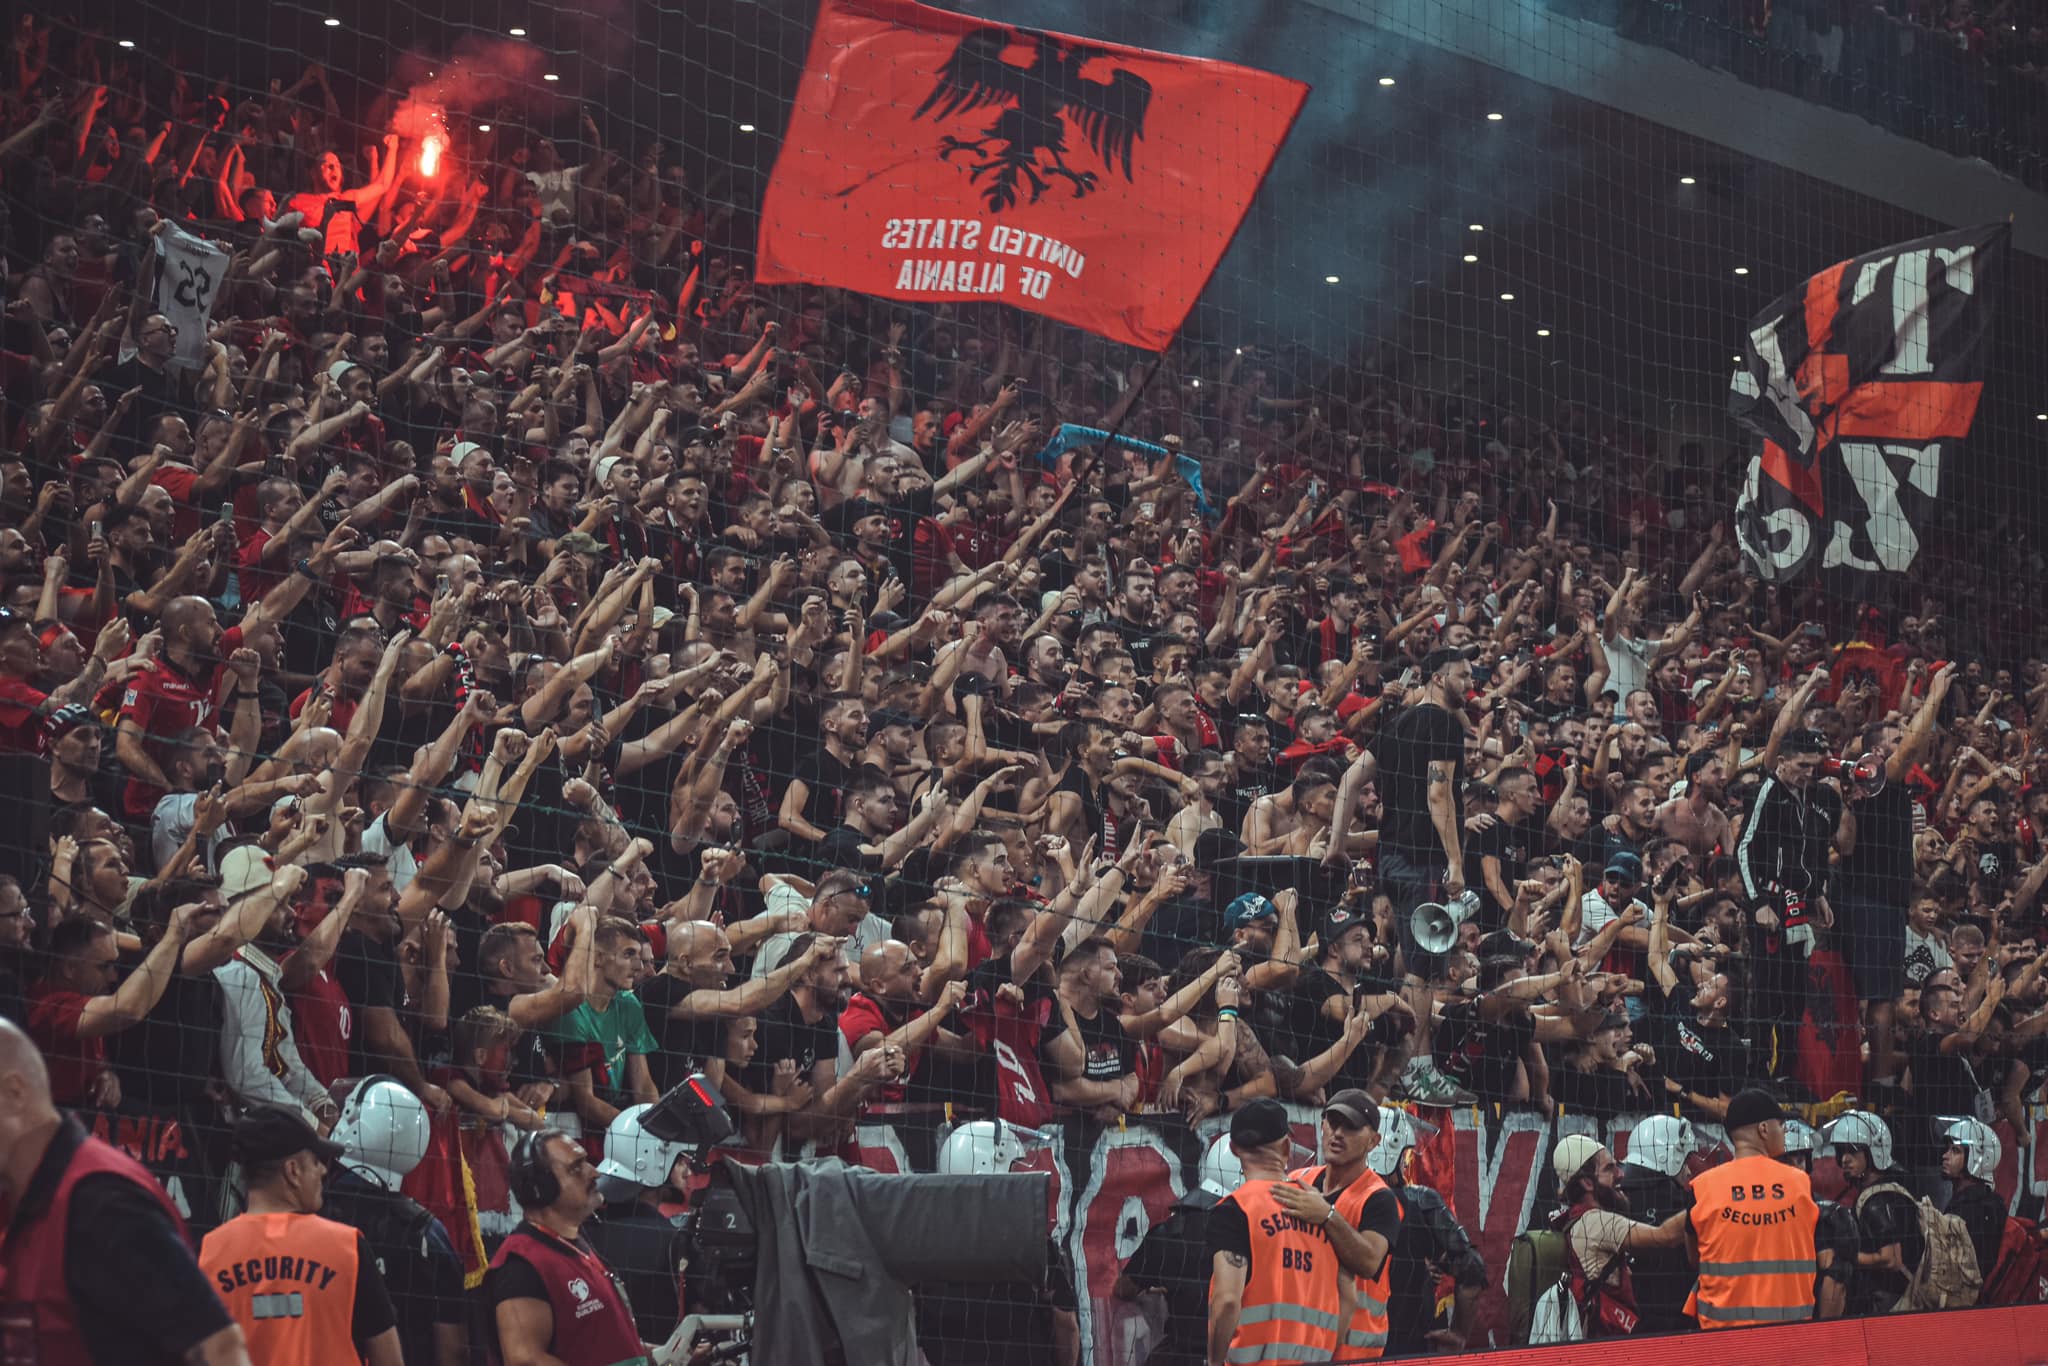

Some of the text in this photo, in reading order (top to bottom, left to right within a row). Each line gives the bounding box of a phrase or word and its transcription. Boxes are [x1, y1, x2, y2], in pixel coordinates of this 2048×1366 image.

[725, 1213, 737, 1229] 2
[1721, 1204, 1797, 1226] SECURITY
[1282, 1247, 1313, 1273] BBS
[216, 1255, 337, 1293] SECURITY
